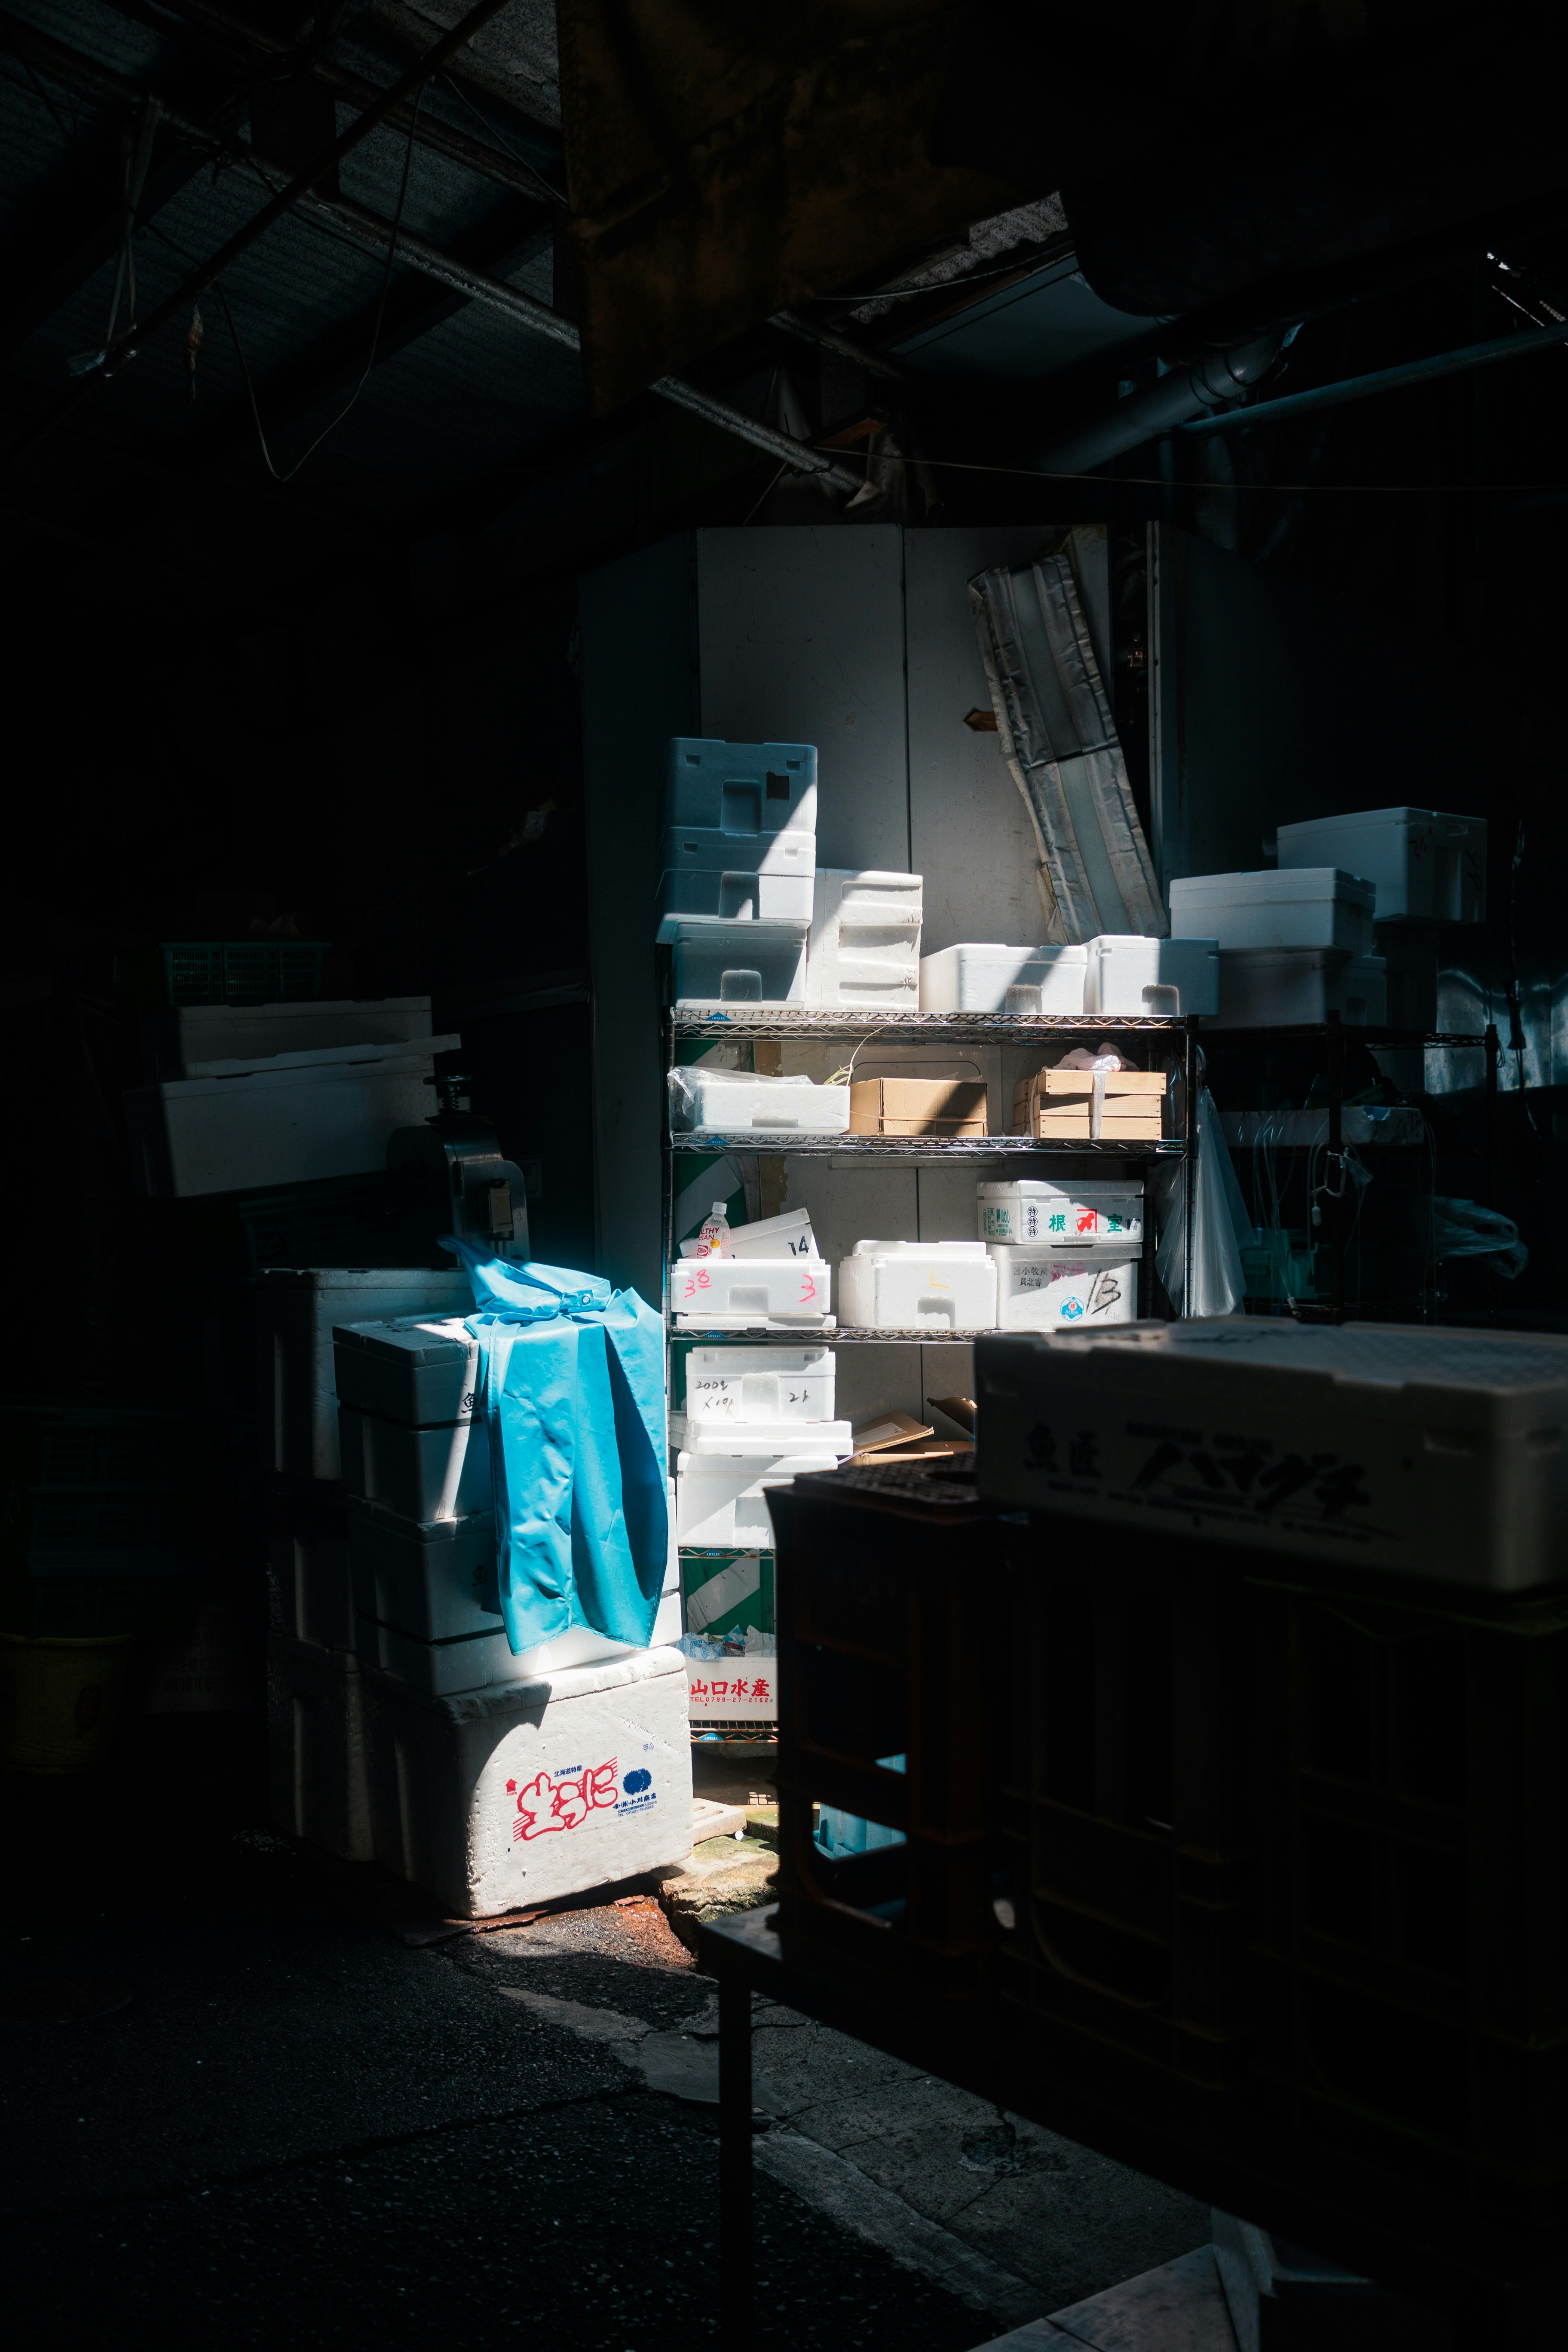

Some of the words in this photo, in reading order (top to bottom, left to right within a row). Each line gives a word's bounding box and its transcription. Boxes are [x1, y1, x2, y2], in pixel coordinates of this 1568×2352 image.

[788, 1236, 809, 1256] 14
[690, 1678, 770, 1697] 山口水産
[554, 1765, 582, 1777] 北海道特産
